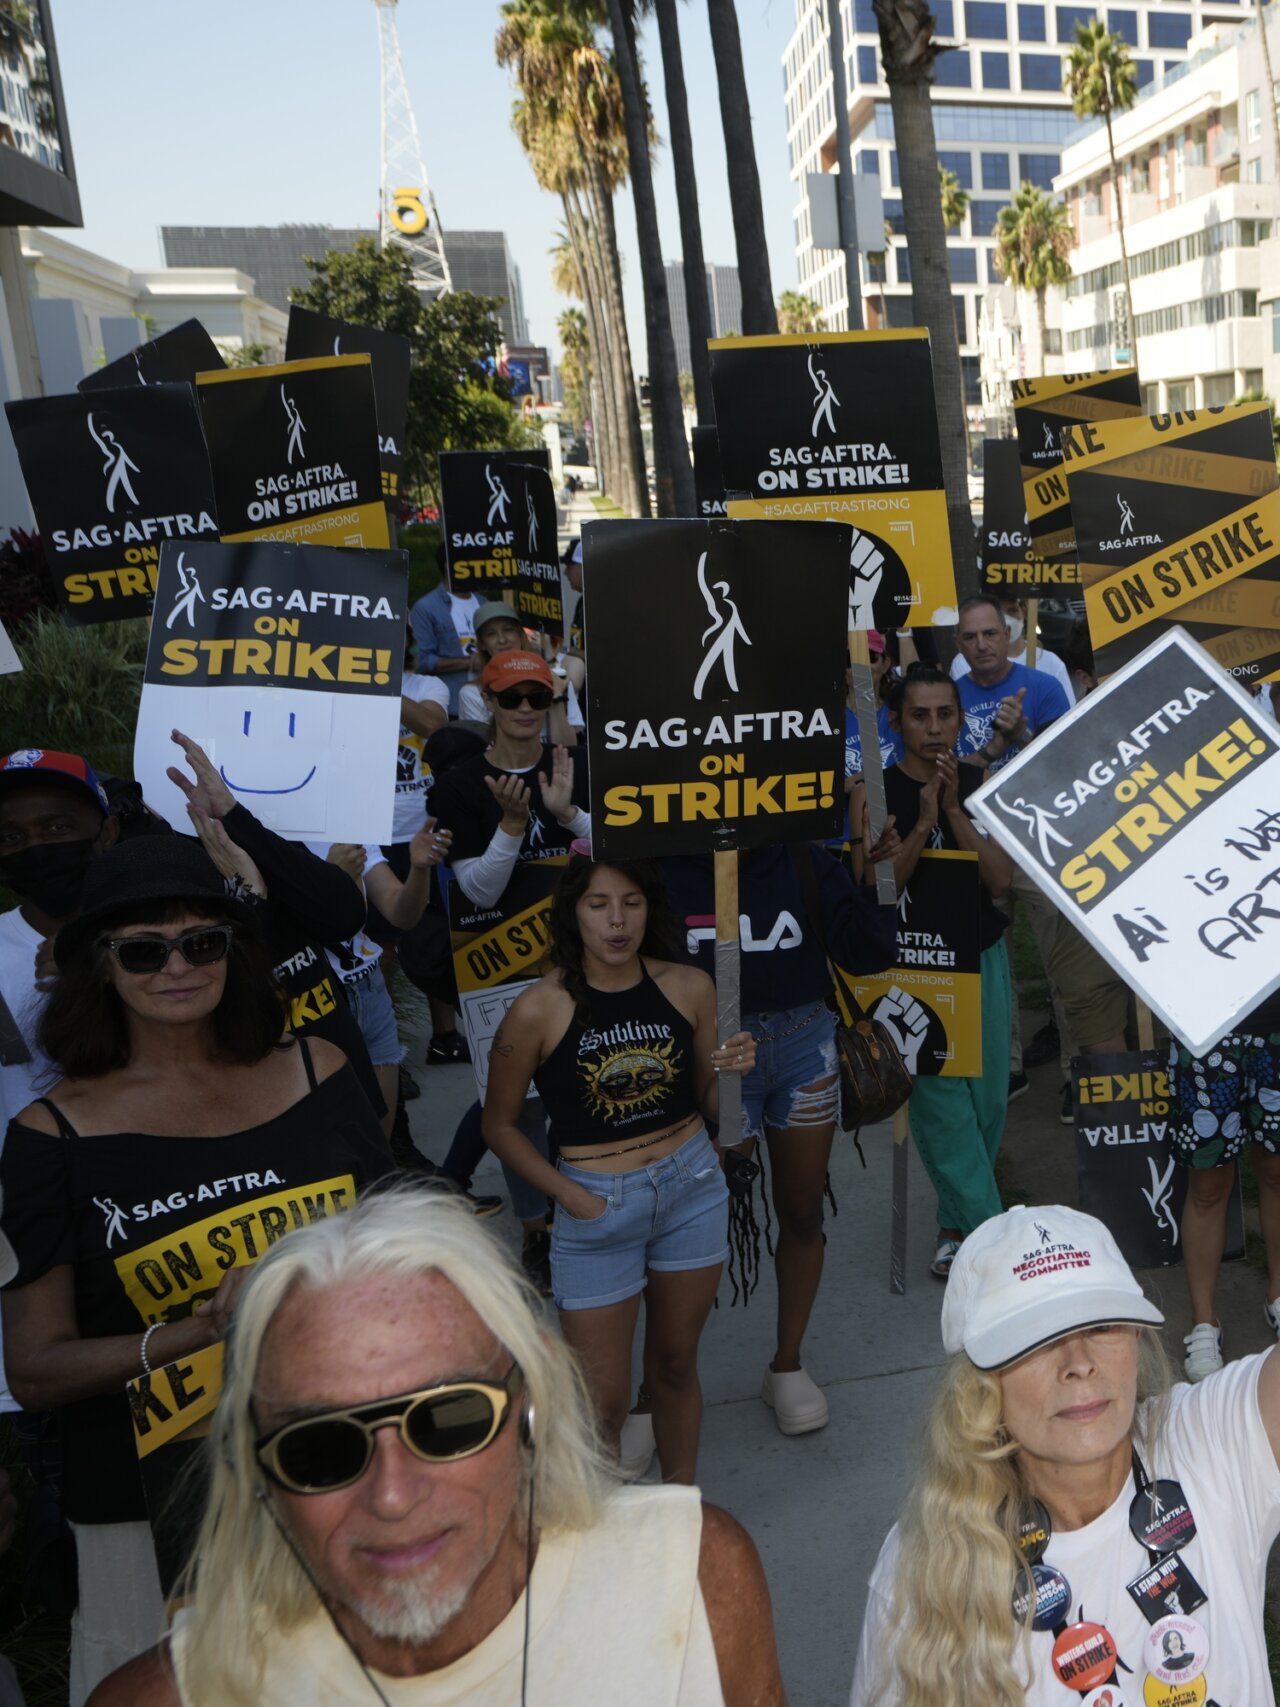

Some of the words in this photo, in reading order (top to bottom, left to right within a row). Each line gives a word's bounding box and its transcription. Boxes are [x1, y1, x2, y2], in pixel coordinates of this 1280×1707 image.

[387, 186, 428, 234] 5
[769, 443, 896, 466] SAG·AFTRA
[1032, 449, 1063, 459] SAG·AFT
[255, 462, 349, 497] SAG·AFTRA
[758, 469, 798, 491] ON
[806, 464, 909, 489] STRIKE!
[1034, 474, 1066, 505] ON
[247, 495, 281, 523] ON
[284, 480, 358, 516] STRIKE!
[763, 498, 911, 517] #SAGAFTRASTRONG
[52, 511, 219, 553] SAG·AFTRA
[452, 531, 515, 547] SAG·AF
[1099, 533, 1163, 551] SAG·AFTRA
[124, 547, 157, 565] ON
[492, 548, 512, 558] ON
[453, 559, 517, 580] STRI
[986, 562, 1082, 584] STRIKE!
[1101, 573, 1155, 624] ON
[1152, 511, 1274, 598] STRIKE
[64, 563, 157, 603] STRI
[533, 582, 542, 593] ON
[211, 586, 397, 620] SAG·AFTRA
[519, 592, 562, 621] STRIKE!
[254, 616, 299, 637] ON
[160, 638, 392, 686] STRIKE!
[970, 701, 995, 713] GUILD
[604, 708, 838, 750] SAG·AFTRA
[845, 735, 861, 745] GUI
[700, 753, 744, 776] ON
[1053, 686, 1214, 817] SAG·AFTRA
[1114, 761, 1159, 802] ON
[603, 770, 834, 827] STRIKE!
[1060, 718, 1266, 903] STRIKE!
[1184, 868, 1229, 896] is
[684, 910, 803, 954] FLA
[895, 931, 946, 948] AFTRA
[467, 939, 511, 981] ON
[896, 949, 956, 966] TRIKE!
[578, 1019, 673, 1056] Sublime
[1078, 1071, 1170, 1104] RIKE!
[1140, 1101, 1169, 1116] ON
[1080, 1121, 1168, 1147] AFTRA
[134, 1169, 284, 1222] SAG·AFTRA
[134, 1241, 201, 1301] ON
[1012, 1251, 1091, 1275] NEGOTIATING
[1019, 1259, 1091, 1281] COMMITTEE
[1134, 1586, 1141, 1597] I
[1139, 1571, 1162, 1594] STAND
[1159, 1557, 1180, 1581] WITH
[1146, 1582, 1162, 1600] THE
[1161, 1573, 1179, 1592] WGA
[1055, 1643, 1086, 1668] WRITERS
[1059, 1664, 1077, 1682] ON
[1076, 1641, 1114, 1672] STRIKE
